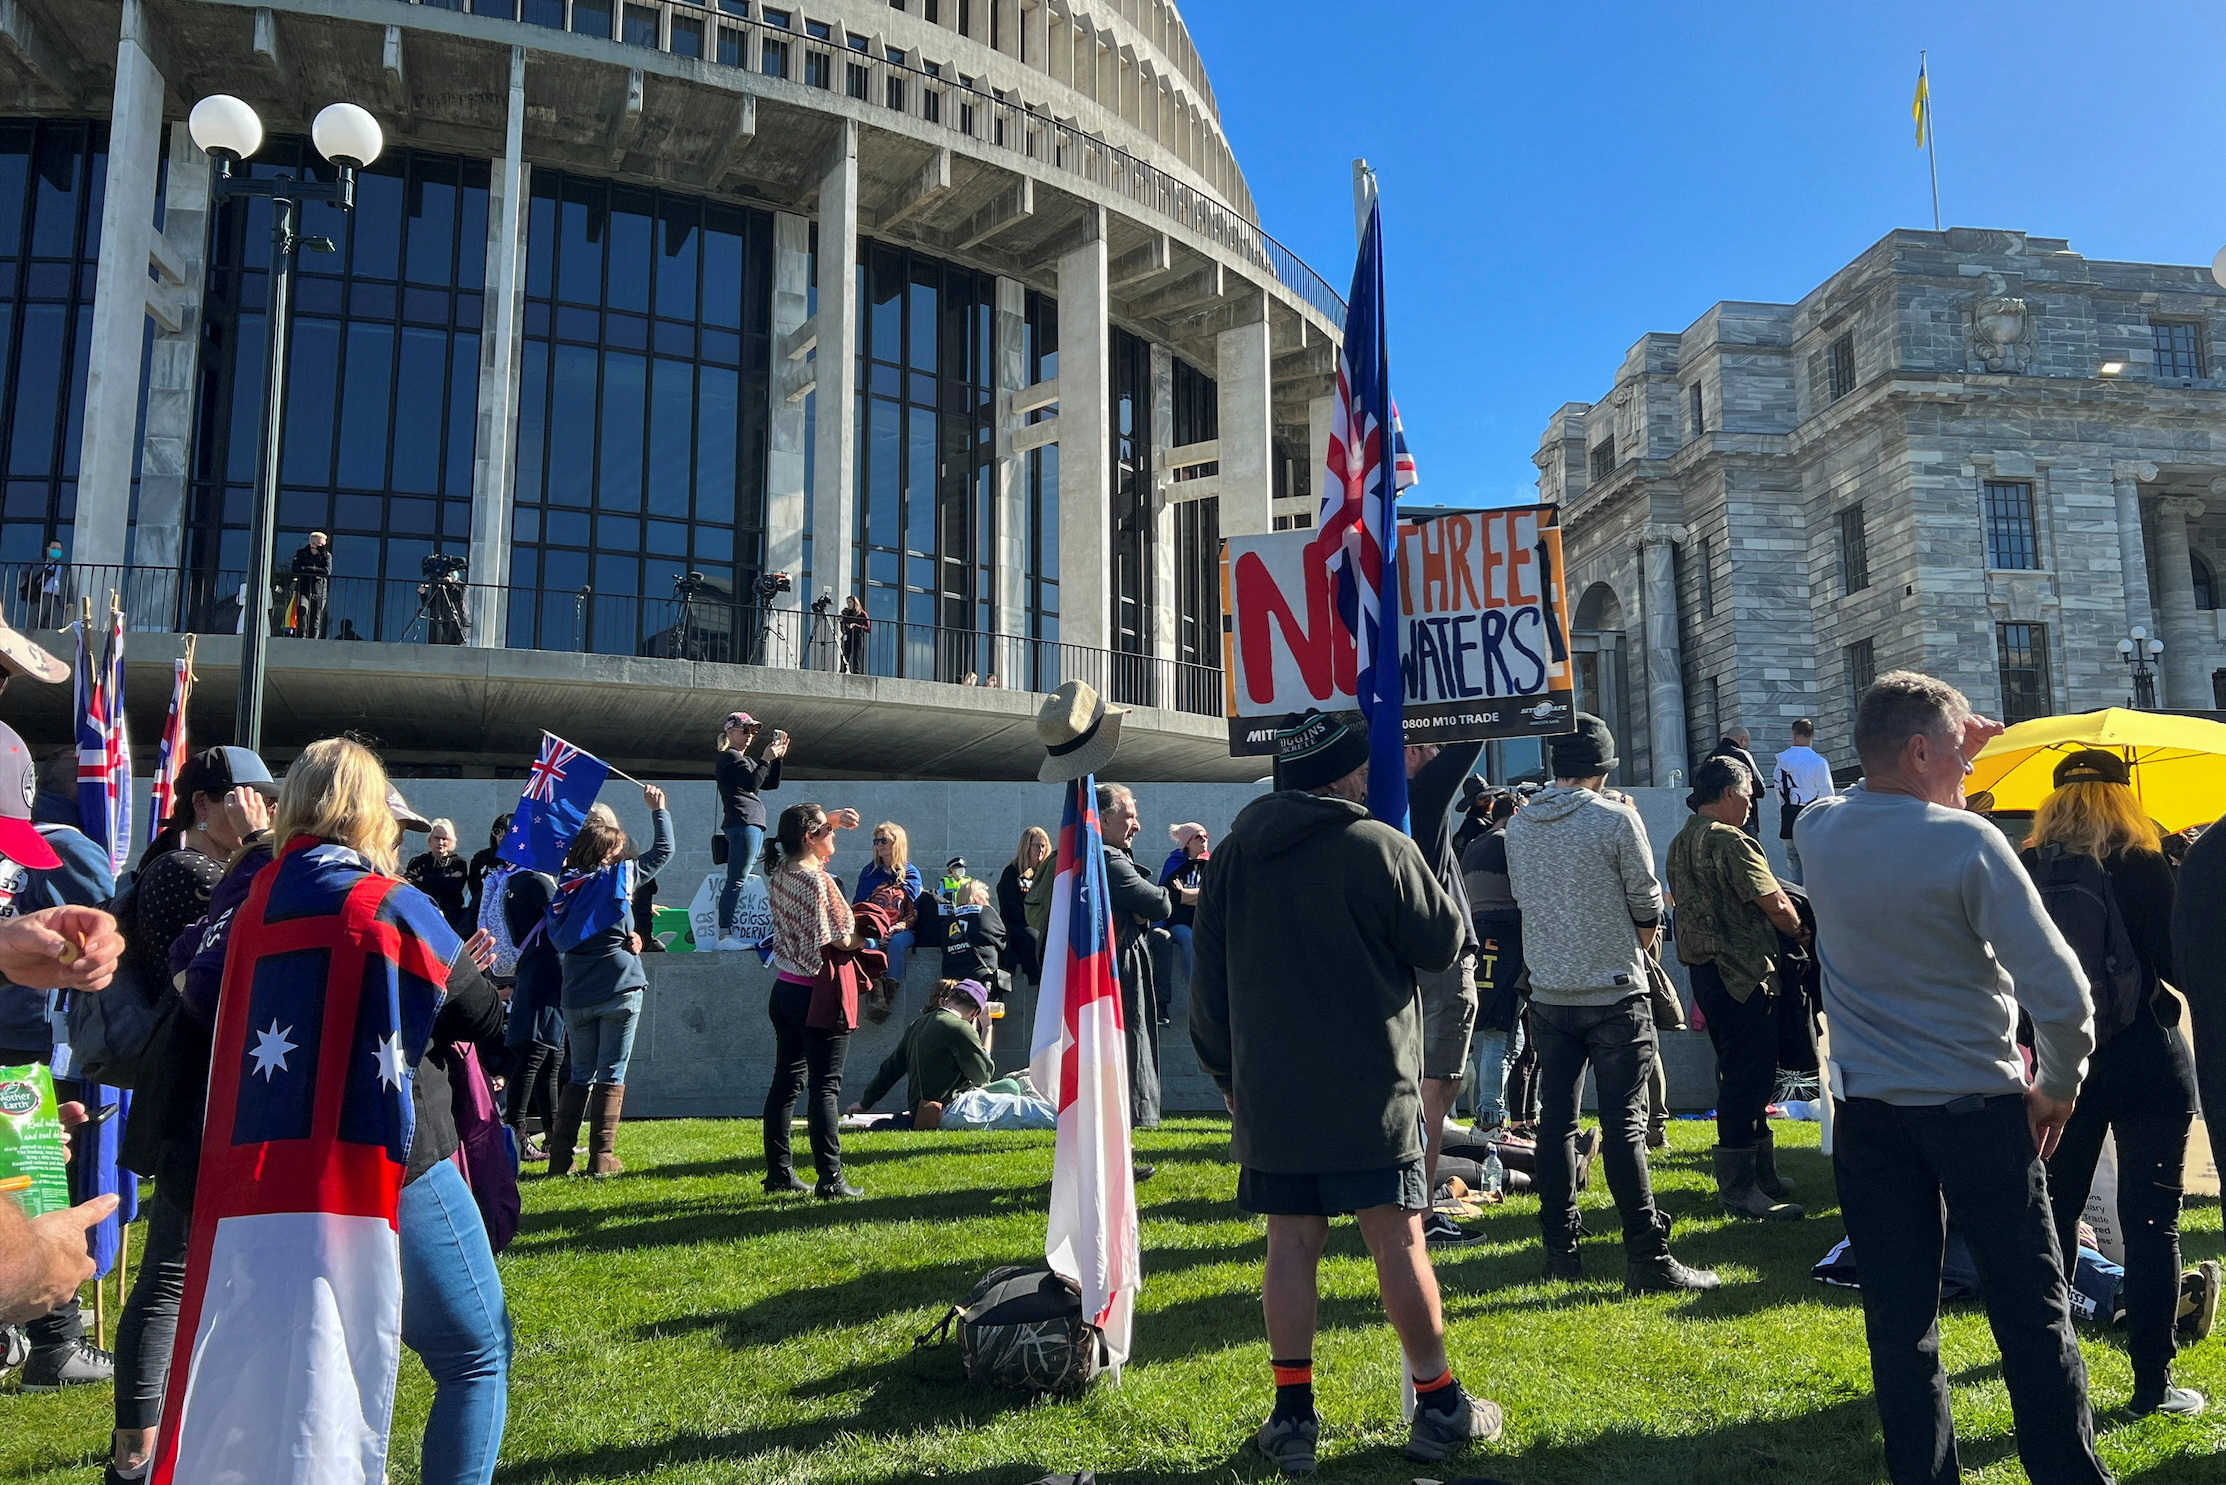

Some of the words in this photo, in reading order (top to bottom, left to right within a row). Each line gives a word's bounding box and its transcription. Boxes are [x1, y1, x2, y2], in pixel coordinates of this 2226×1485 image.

[1397, 510, 1538, 616] THREE
[1402, 716, 1430, 730] 0800
[1432, 715, 1457, 728] M10
[1458, 712, 1500, 725] TRADE
[1246, 728, 1278, 743] MIT
[3, 1101, 29, 1110] Earth
